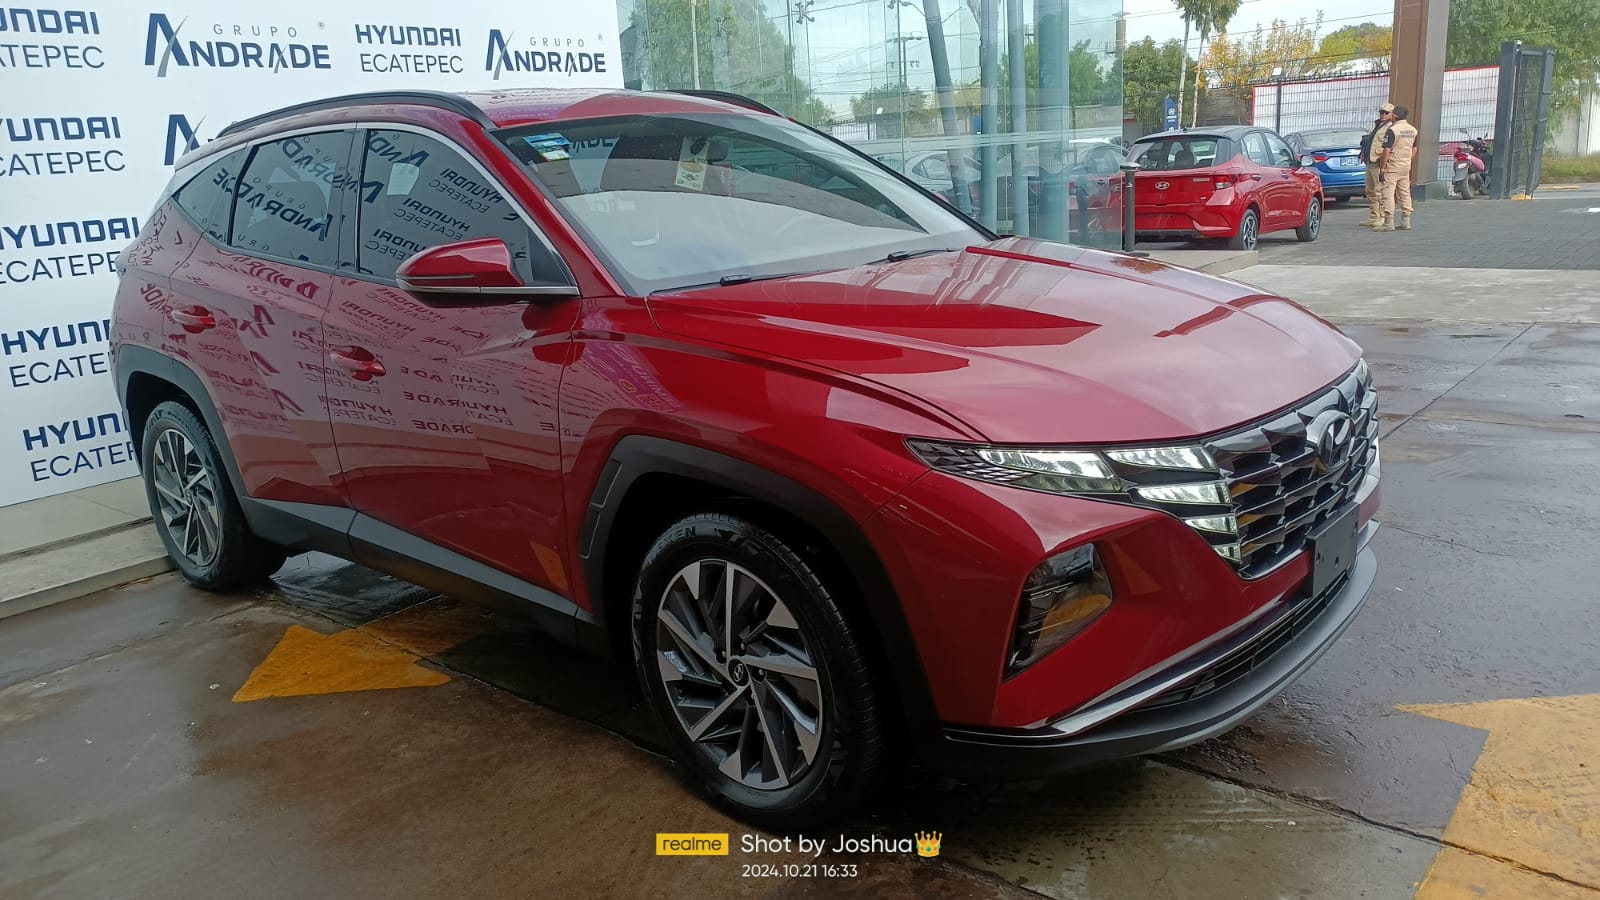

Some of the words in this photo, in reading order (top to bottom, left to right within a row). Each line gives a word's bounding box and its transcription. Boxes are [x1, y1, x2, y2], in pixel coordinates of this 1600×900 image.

[0, 8, 100, 35] NDAI
[213, 24, 298, 38] GRUPO
[355, 24, 462, 47] HYUNDAI
[0, 44, 105, 69] TEPEC
[145, 13, 332, 78] ANDRADE
[485, 29, 607, 80] ANDRADE
[529, 36, 585, 48] GRUPO
[359, 53, 464, 74] ECATEPEC
[0, 117, 121, 142] UNDAI
[0, 150, 126, 177] ATEPEC
[0, 217, 140, 250] YUNDAI
[0, 251, 121, 284] CATEPE
[1, 319, 111, 355] HYUN
[9, 352, 110, 387] ECATE
[23, 411, 128, 451] HYUN
[31, 442, 134, 481] ECATE
